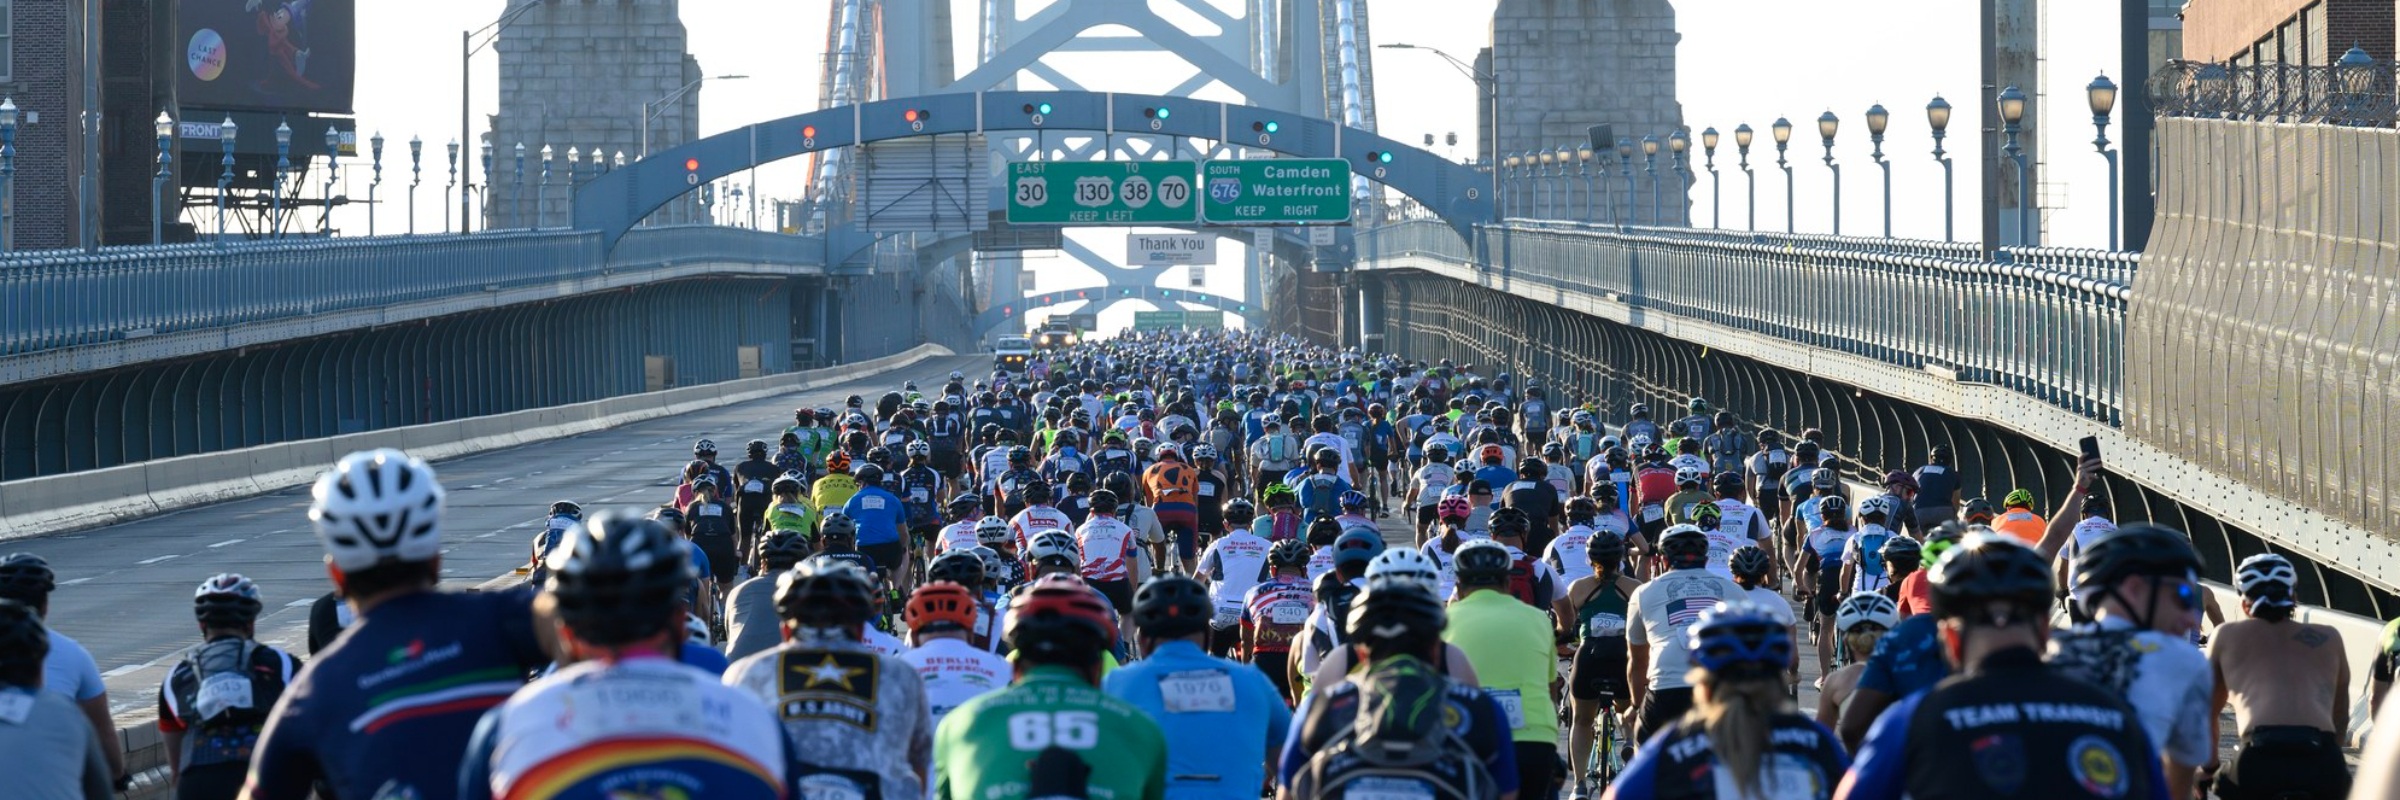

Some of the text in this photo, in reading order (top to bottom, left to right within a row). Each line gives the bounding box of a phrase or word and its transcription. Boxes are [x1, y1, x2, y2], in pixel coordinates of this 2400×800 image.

[198, 43, 217, 54] LAST
[190, 52, 221, 68] CHANCE
[1016, 163, 1139, 173] EAST TO
[1209, 166, 1240, 175] SOUTH
[1264, 166, 1330, 178] Camden
[1019, 183, 1186, 201] 30 130 38 70
[1211, 184, 1239, 198] 676
[1252, 184, 1341, 196] Waterfront
[1069, 211, 1135, 221] KEEP LEFT
[1235, 205, 1318, 216] KEEP RIGHT
[1139, 237, 1205, 250] Thank You
[1720, 525, 1737, 533] 280
[1280, 608, 1301, 616] 340
[1597, 618, 1618, 629] 297
[926, 657, 980, 666] BERLIN
[1173, 681, 1222, 695] 1976
[1944, 702, 2124, 732] TEAM TRANSIT
[1008, 711, 1099, 750] 65
[1668, 732, 1713, 763] TEA
